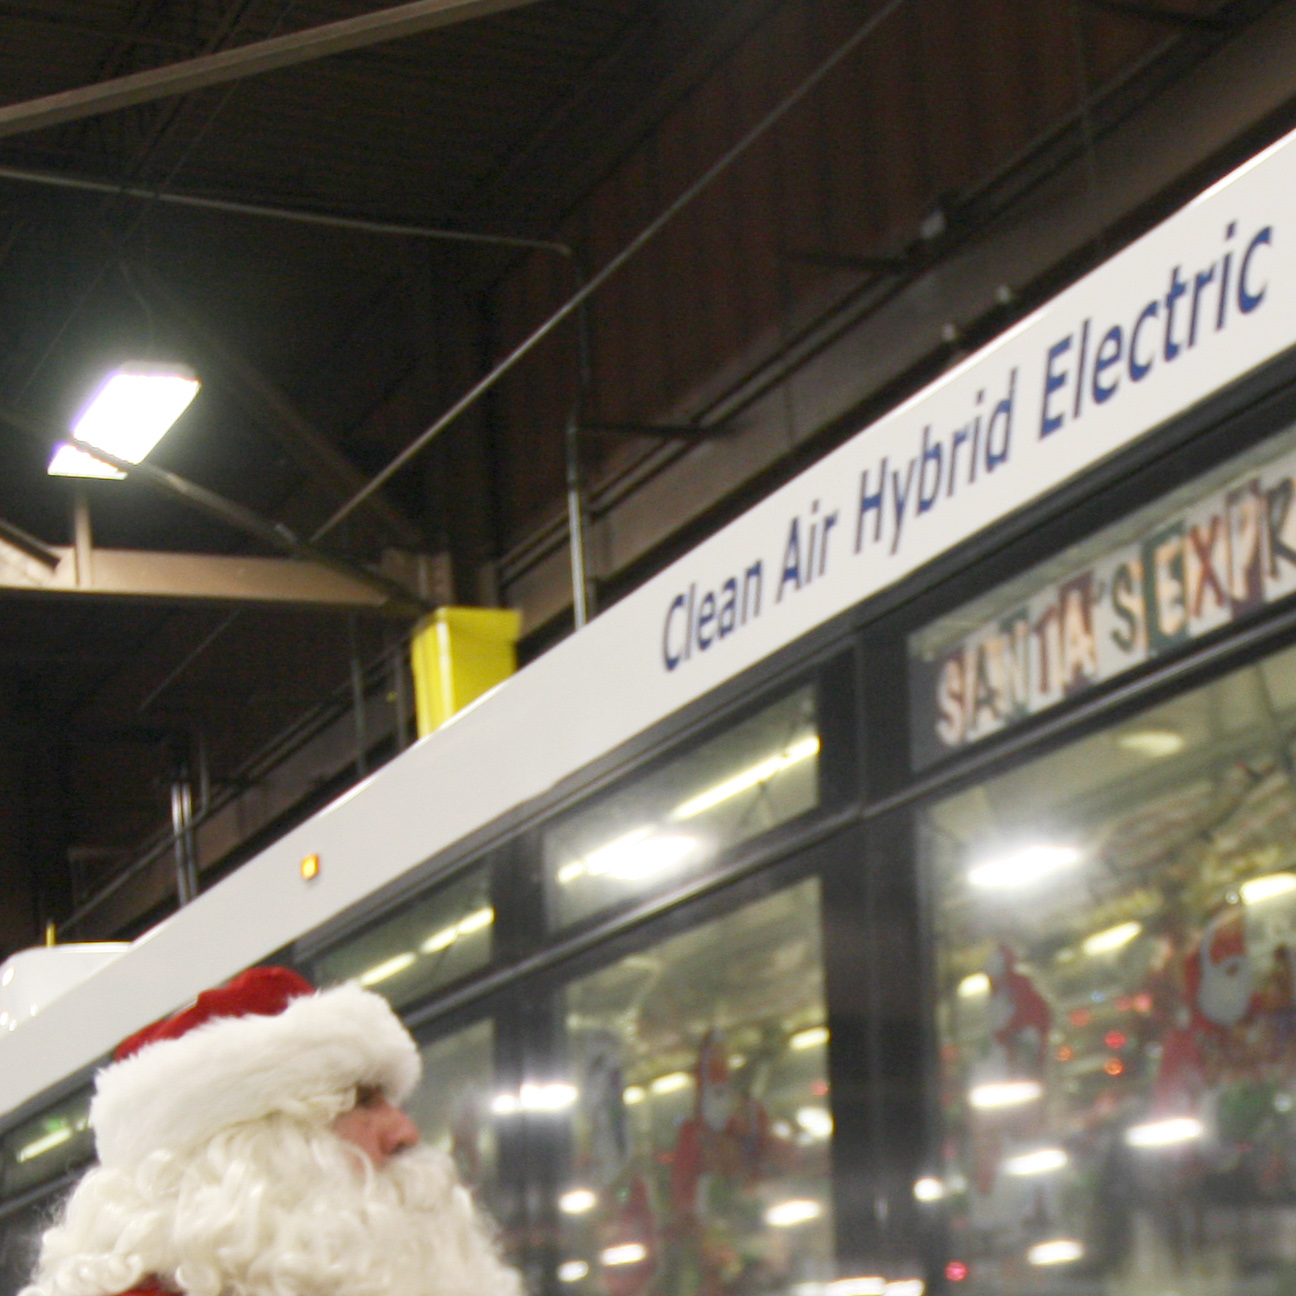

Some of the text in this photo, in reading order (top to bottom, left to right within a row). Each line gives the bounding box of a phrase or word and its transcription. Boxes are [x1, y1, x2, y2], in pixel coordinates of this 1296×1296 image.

[661, 559, 764, 673] Clean
[774, 501, 837, 604] Air
[854, 367, 1019, 556] Hybrid
[1035, 219, 1271, 440] Electric
